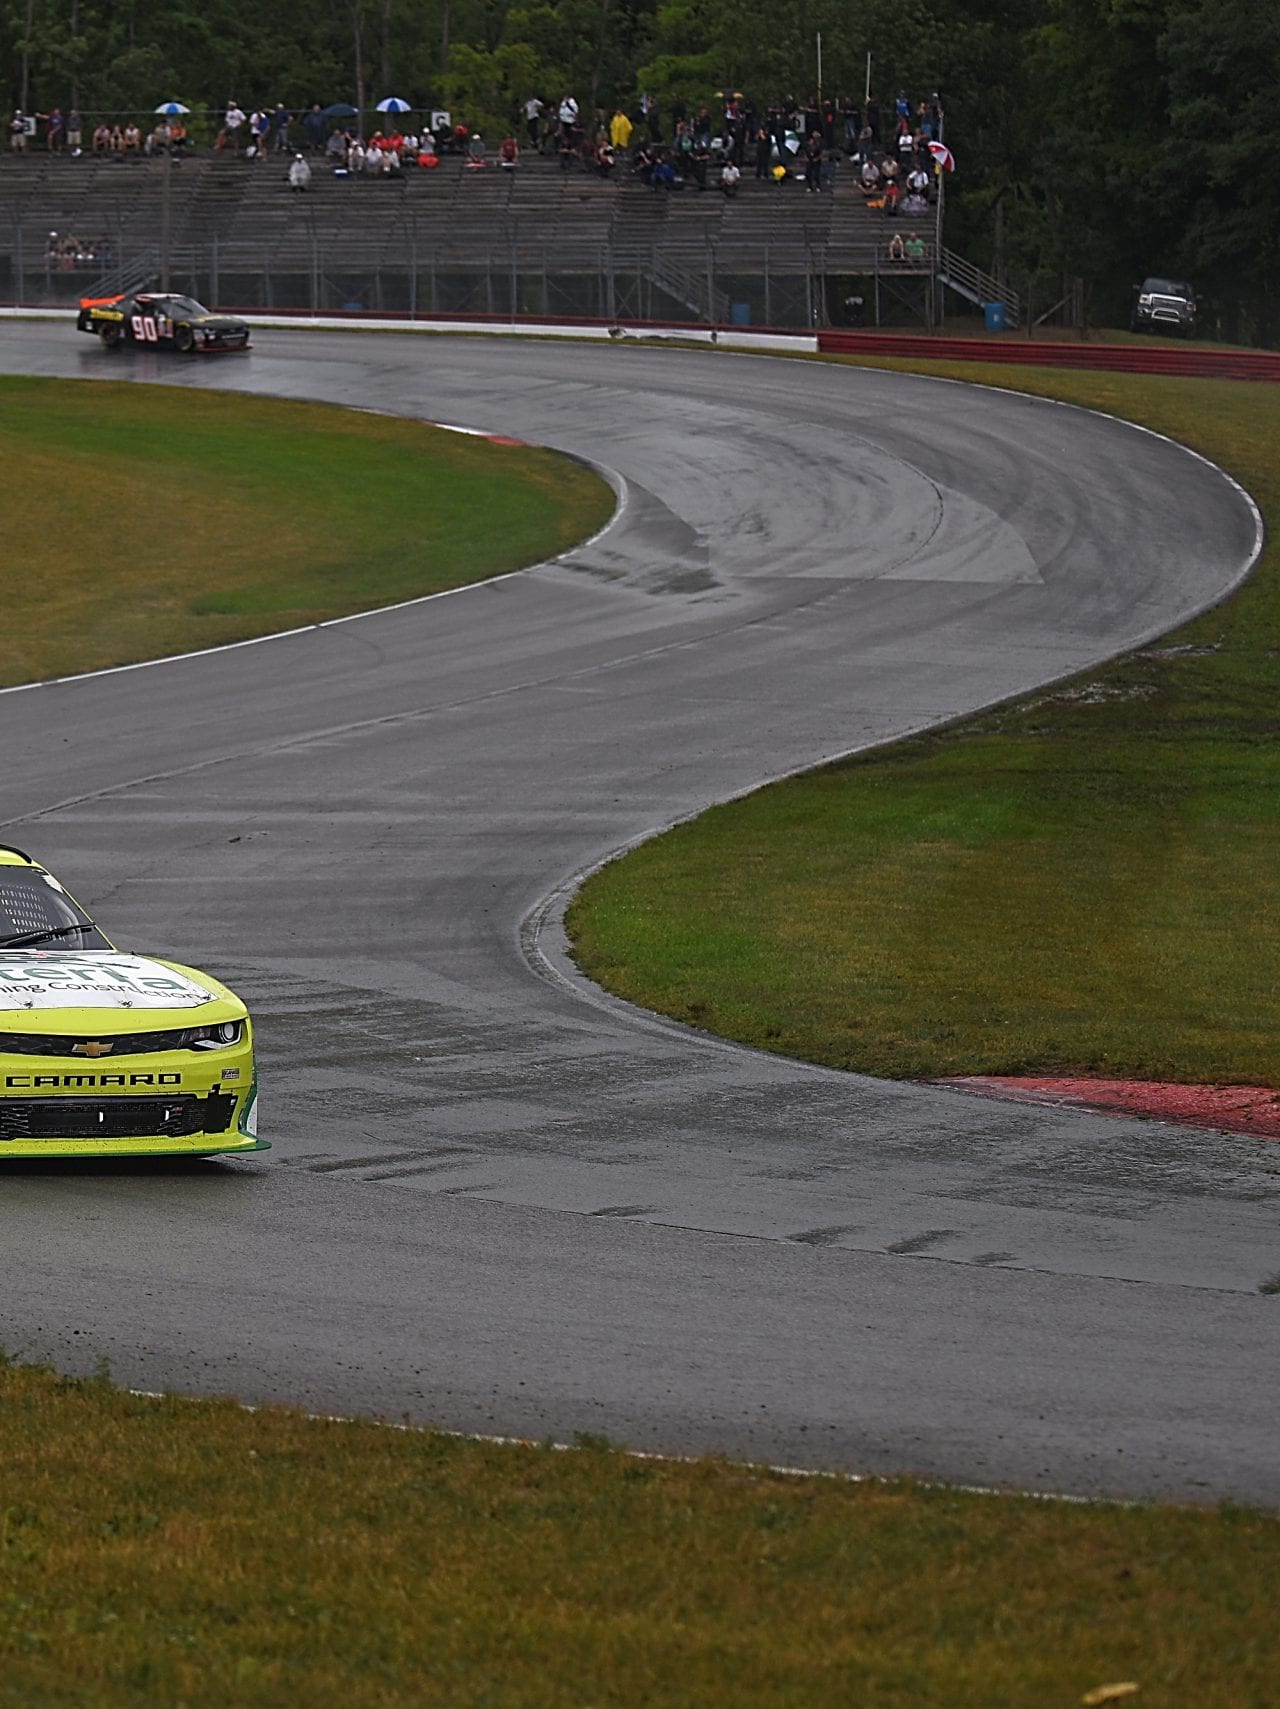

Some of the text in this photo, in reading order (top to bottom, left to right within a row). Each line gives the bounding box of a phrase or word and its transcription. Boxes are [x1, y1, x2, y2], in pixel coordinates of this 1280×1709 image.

[131, 315, 158, 341] 90
[48, 981, 205, 1000] Construction
[6, 1073, 181, 1087] CAMARO
